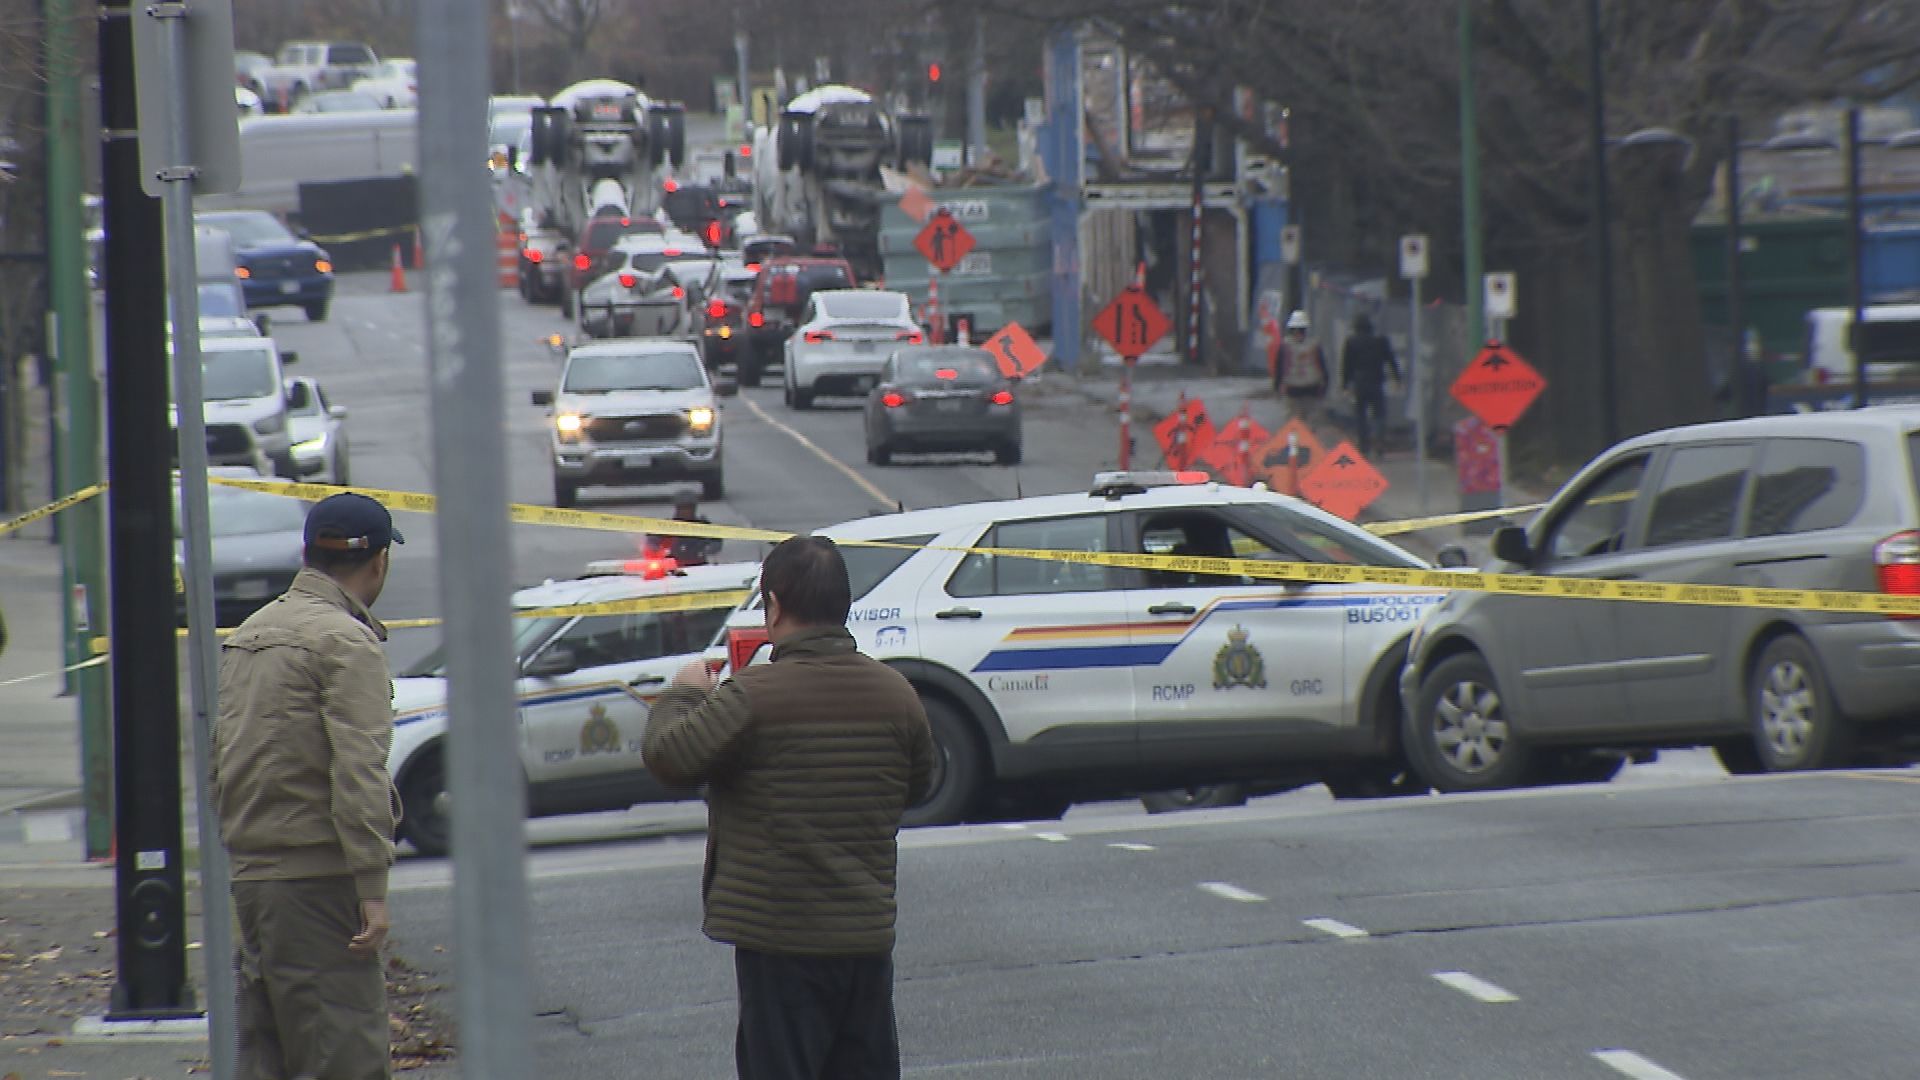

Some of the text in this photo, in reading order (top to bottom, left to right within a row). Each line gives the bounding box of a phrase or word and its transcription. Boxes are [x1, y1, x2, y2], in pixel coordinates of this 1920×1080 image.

[1348, 607, 1419, 623] BU5061
[875, 635, 906, 648] 9-1-1
[988, 674, 1049, 692] Canada
[1152, 679, 1322, 701] RCMP GRC
